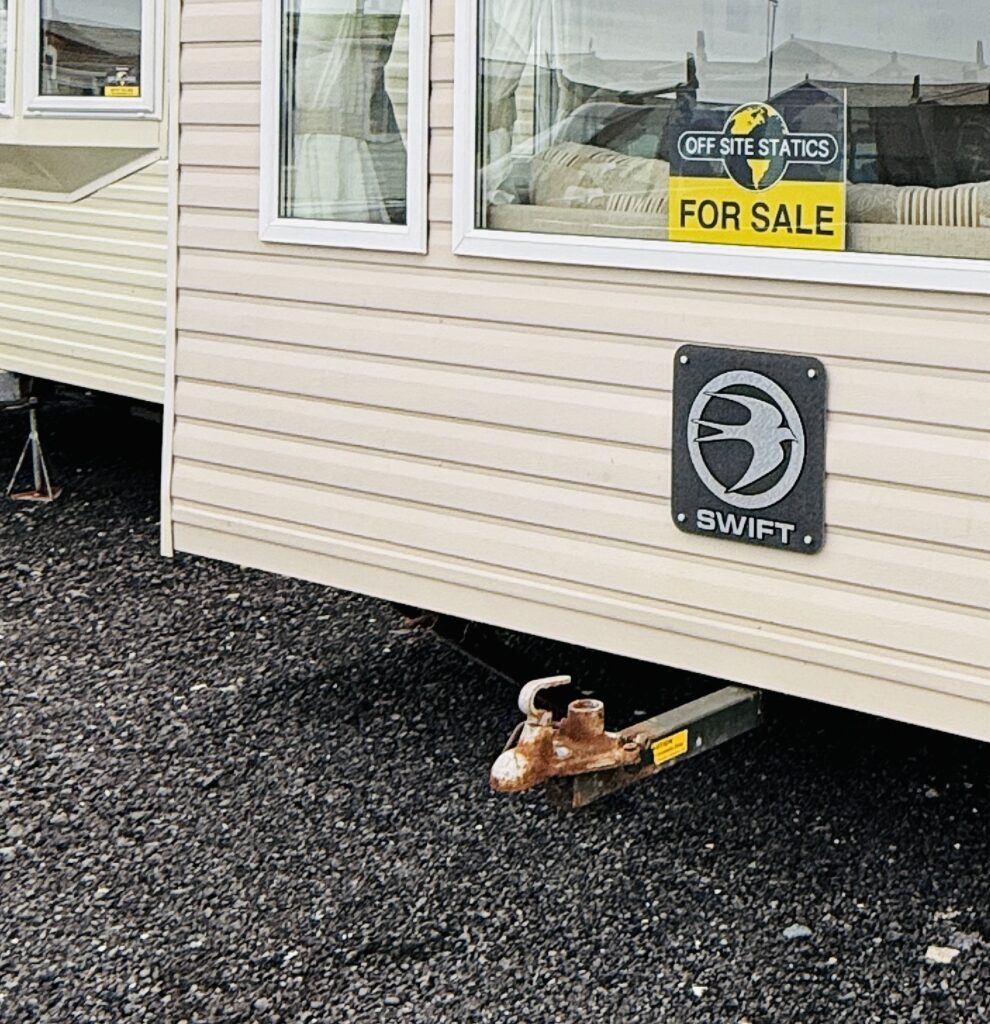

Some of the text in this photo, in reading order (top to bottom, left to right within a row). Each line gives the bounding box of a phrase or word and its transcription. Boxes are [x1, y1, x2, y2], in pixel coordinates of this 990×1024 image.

[685, 136, 830, 158] OFF SITE STATICS
[679, 199, 835, 236] FOR SALE
[696, 508, 795, 545] SWIFT
